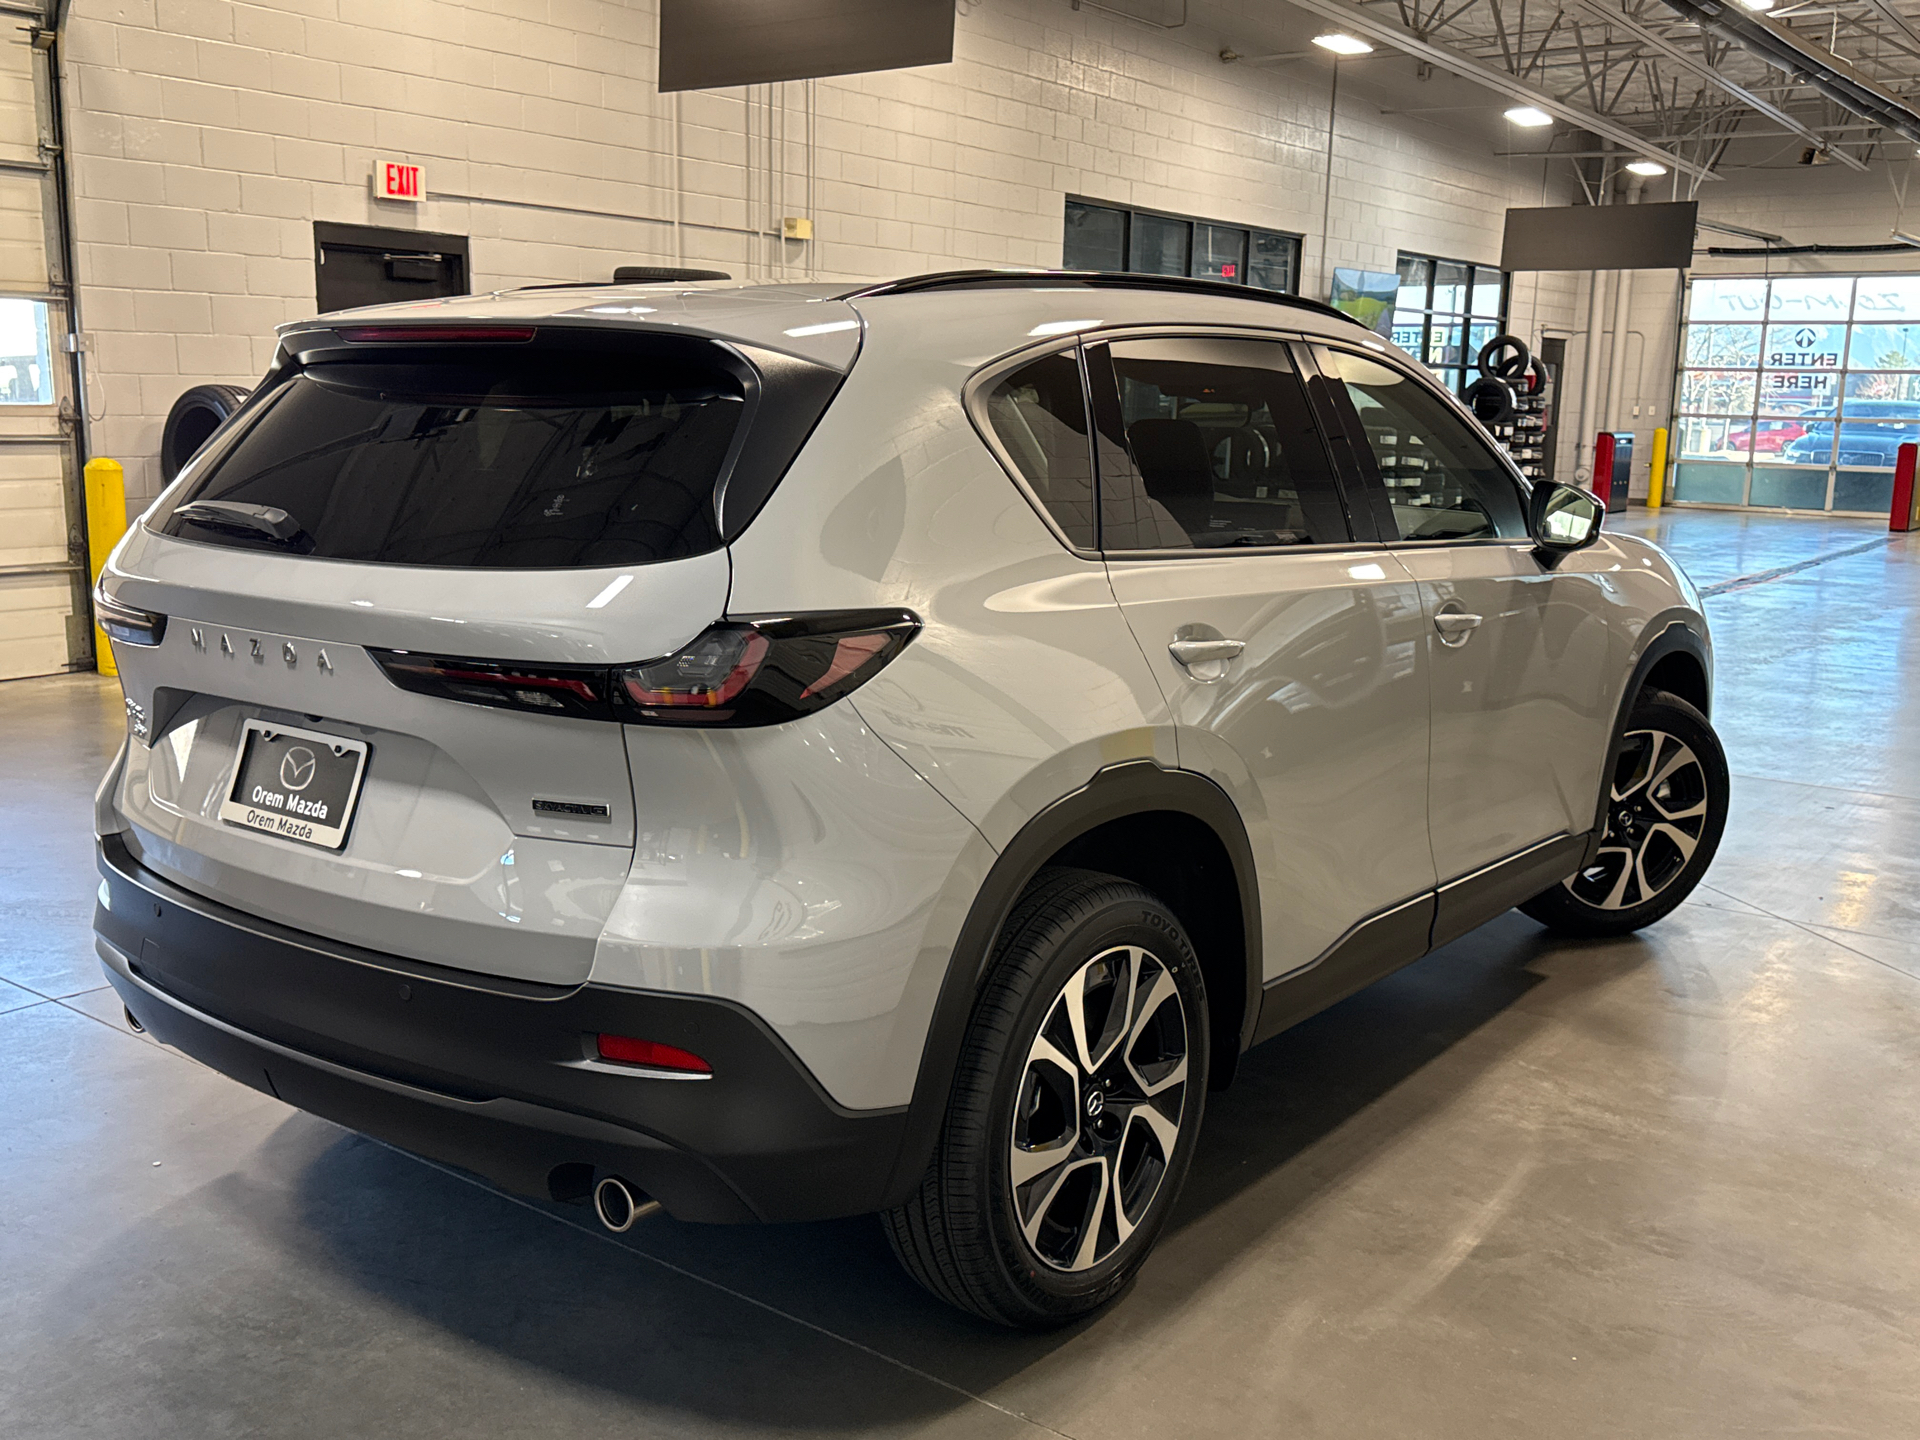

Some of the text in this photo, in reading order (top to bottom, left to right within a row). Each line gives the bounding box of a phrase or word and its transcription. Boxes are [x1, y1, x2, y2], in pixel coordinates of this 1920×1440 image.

[386, 163, 419, 197] EXIT
[191, 627, 334, 671] MAZDA
[252, 785, 329, 819] Orem Mazda
[246, 809, 313, 840] Orem Mazda
[1141, 910, 1180, 942] TOYO
